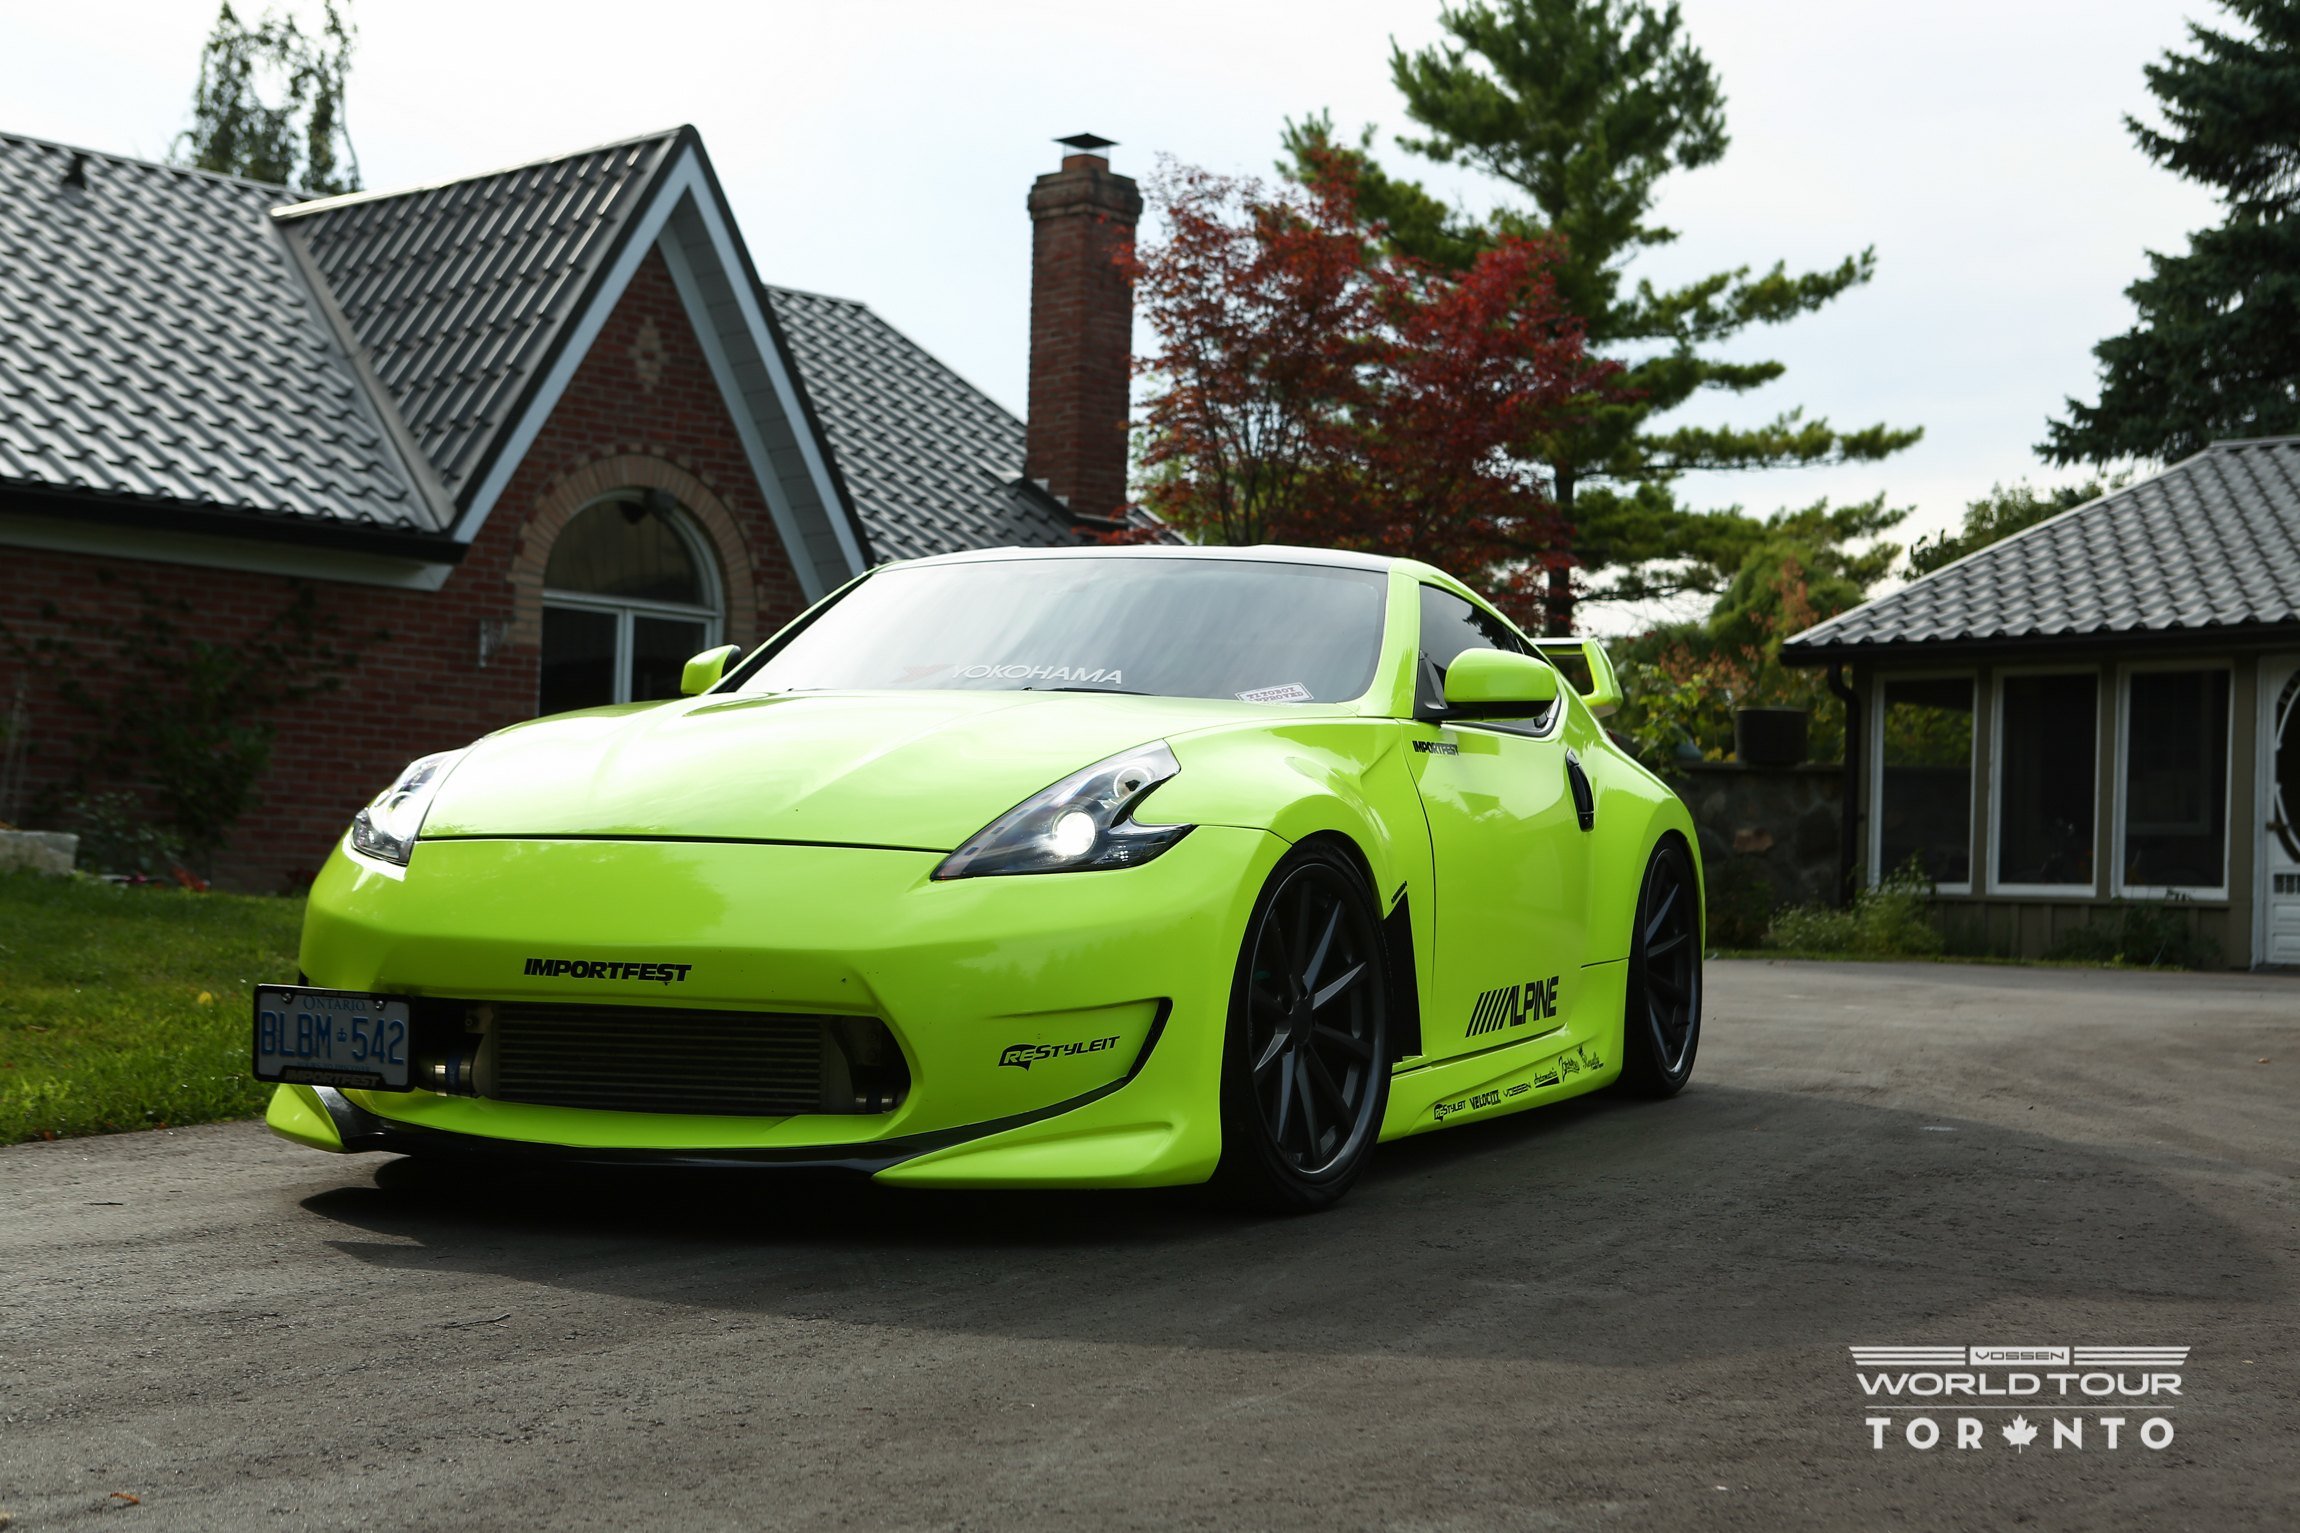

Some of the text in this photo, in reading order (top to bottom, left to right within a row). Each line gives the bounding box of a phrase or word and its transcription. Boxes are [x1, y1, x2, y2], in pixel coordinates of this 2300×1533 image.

[952, 664, 1122, 685] YOKOHAMA
[1412, 740, 1460, 756] IMPORTFEST
[524, 958, 692, 982] IMPORTFEST
[303, 996, 366, 1012] ONTARIO
[1497, 975, 1560, 1030] ALPINE
[261, 1010, 405, 1066] BLBM 542
